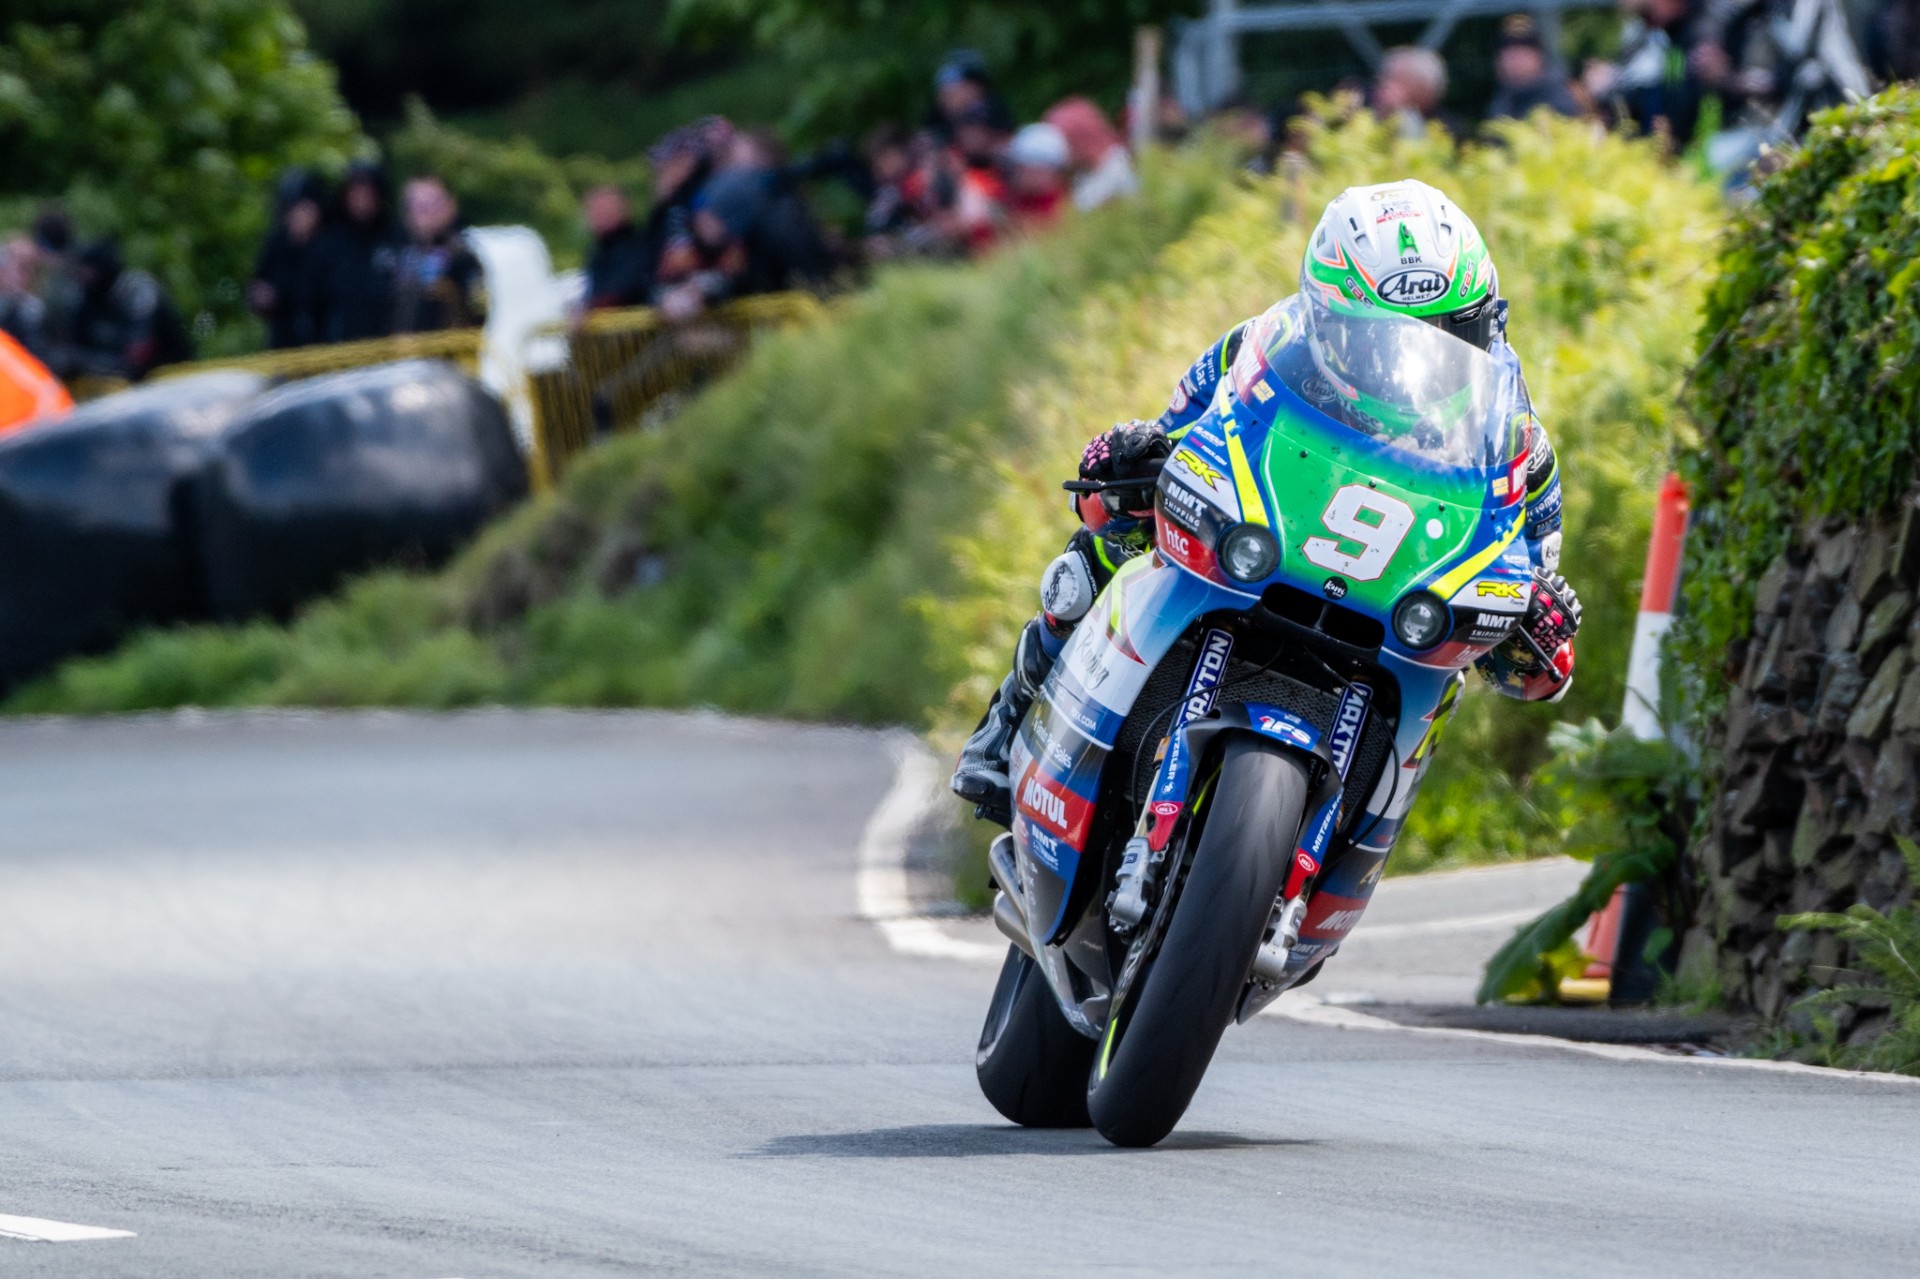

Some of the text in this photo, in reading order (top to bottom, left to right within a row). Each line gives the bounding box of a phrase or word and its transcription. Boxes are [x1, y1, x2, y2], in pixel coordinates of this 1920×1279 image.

[1400, 256, 1423, 265] BBK
[1390, 273, 1443, 296] Arai
[1402, 293, 1431, 302] HELMET
[1164, 498, 1201, 528] SHIPPING
[1166, 481, 1209, 517] NMT
[1165, 522, 1190, 556] htc
[1301, 483, 1416, 582] 9
[1474, 580, 1526, 599] RK
[1476, 612, 1516, 631] NMT
[1333, 687, 1369, 775] MAXTO
[1022, 777, 1068, 830] MOTUL
[1031, 823, 1058, 857] NMT
